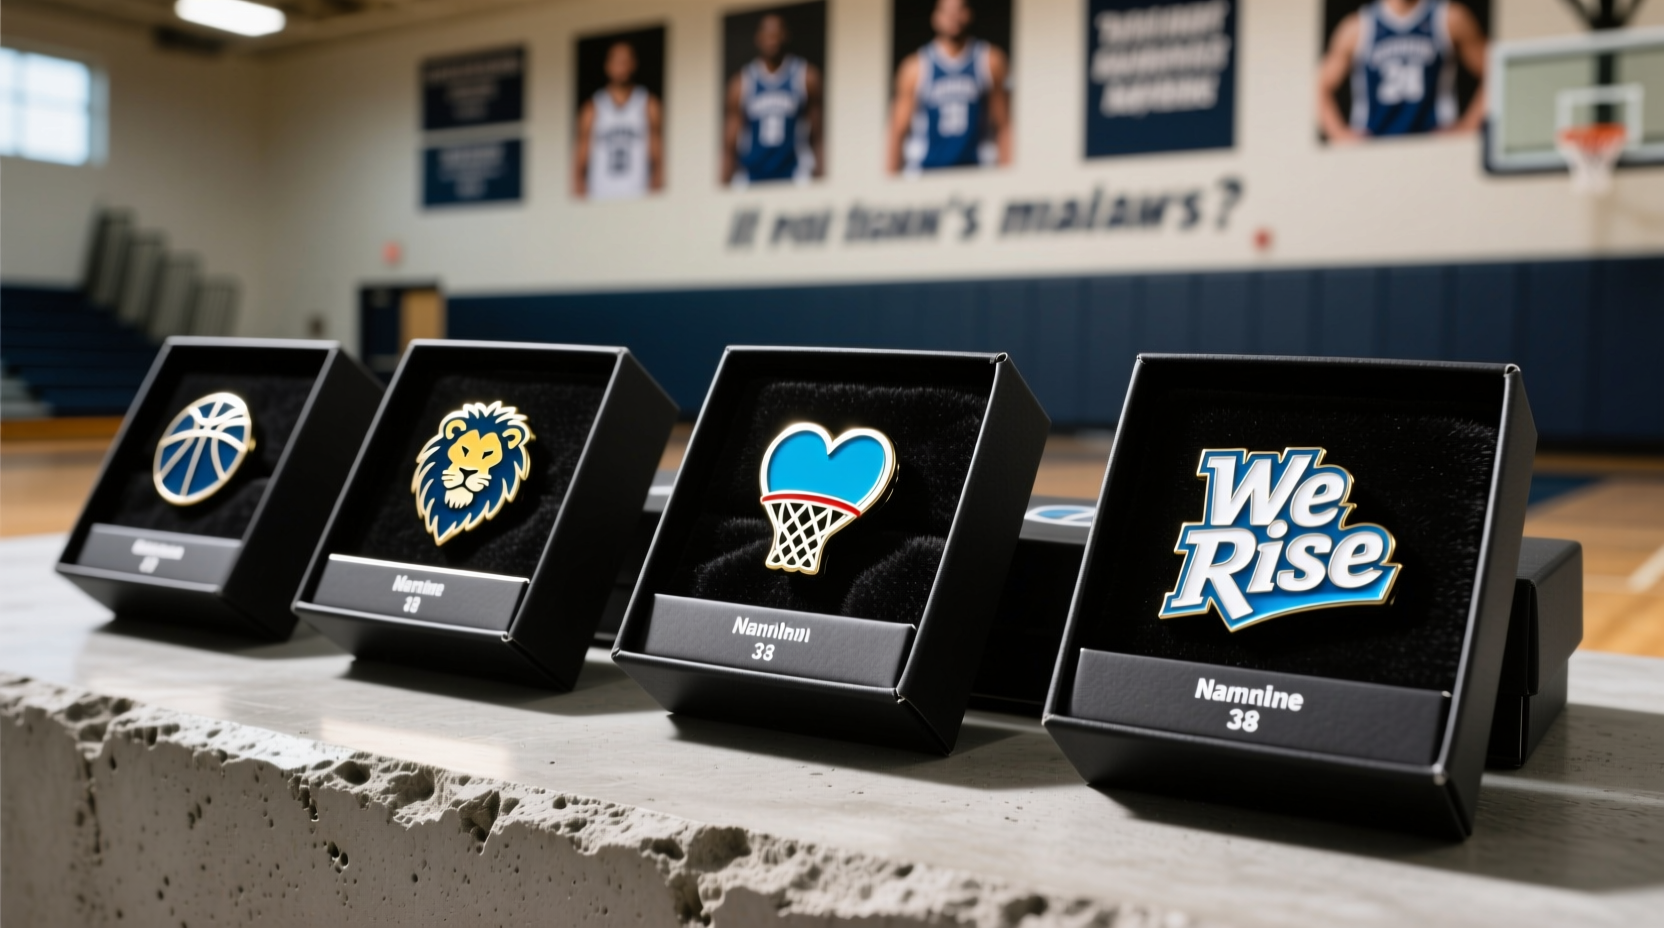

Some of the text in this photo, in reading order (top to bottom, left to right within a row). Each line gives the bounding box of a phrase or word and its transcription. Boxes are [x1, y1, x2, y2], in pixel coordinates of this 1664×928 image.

[1206, 453, 1345, 528] We
[1169, 519, 1385, 620] Rise
[751, 642, 775, 661] 38
[1194, 677, 1304, 712] Namnine
[1226, 708, 1260, 732] 38
